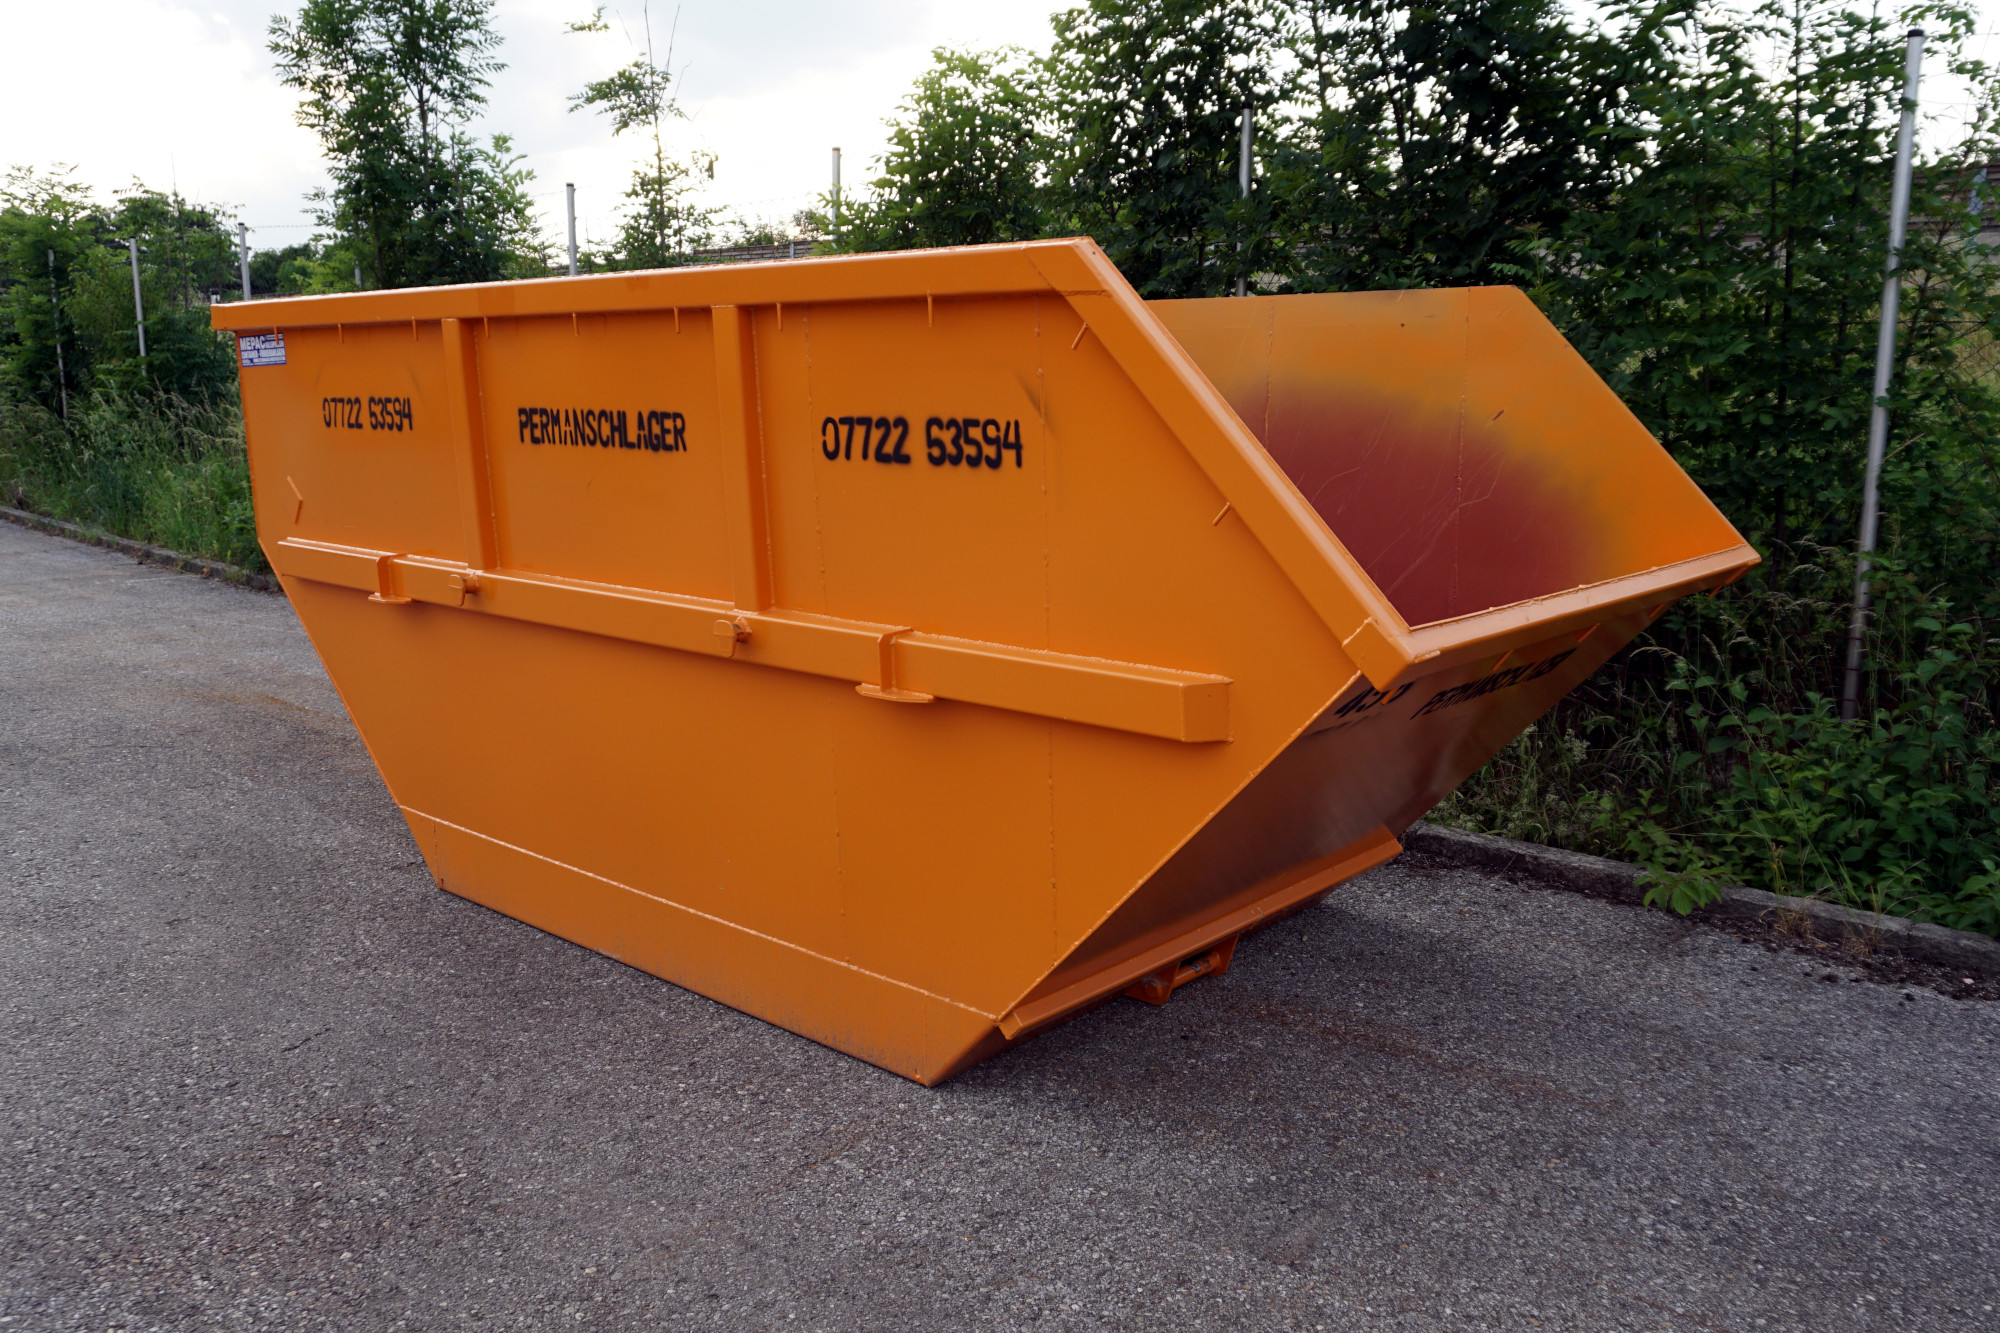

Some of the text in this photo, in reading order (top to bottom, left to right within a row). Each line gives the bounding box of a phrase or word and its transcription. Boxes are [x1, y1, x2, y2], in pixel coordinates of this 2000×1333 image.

[239, 335, 266, 351] MEPAC
[322, 396, 413, 431] 07722 63594
[518, 407, 687, 452] PERMANSCHLAGER
[822, 416, 1023, 469] 07722 63594
